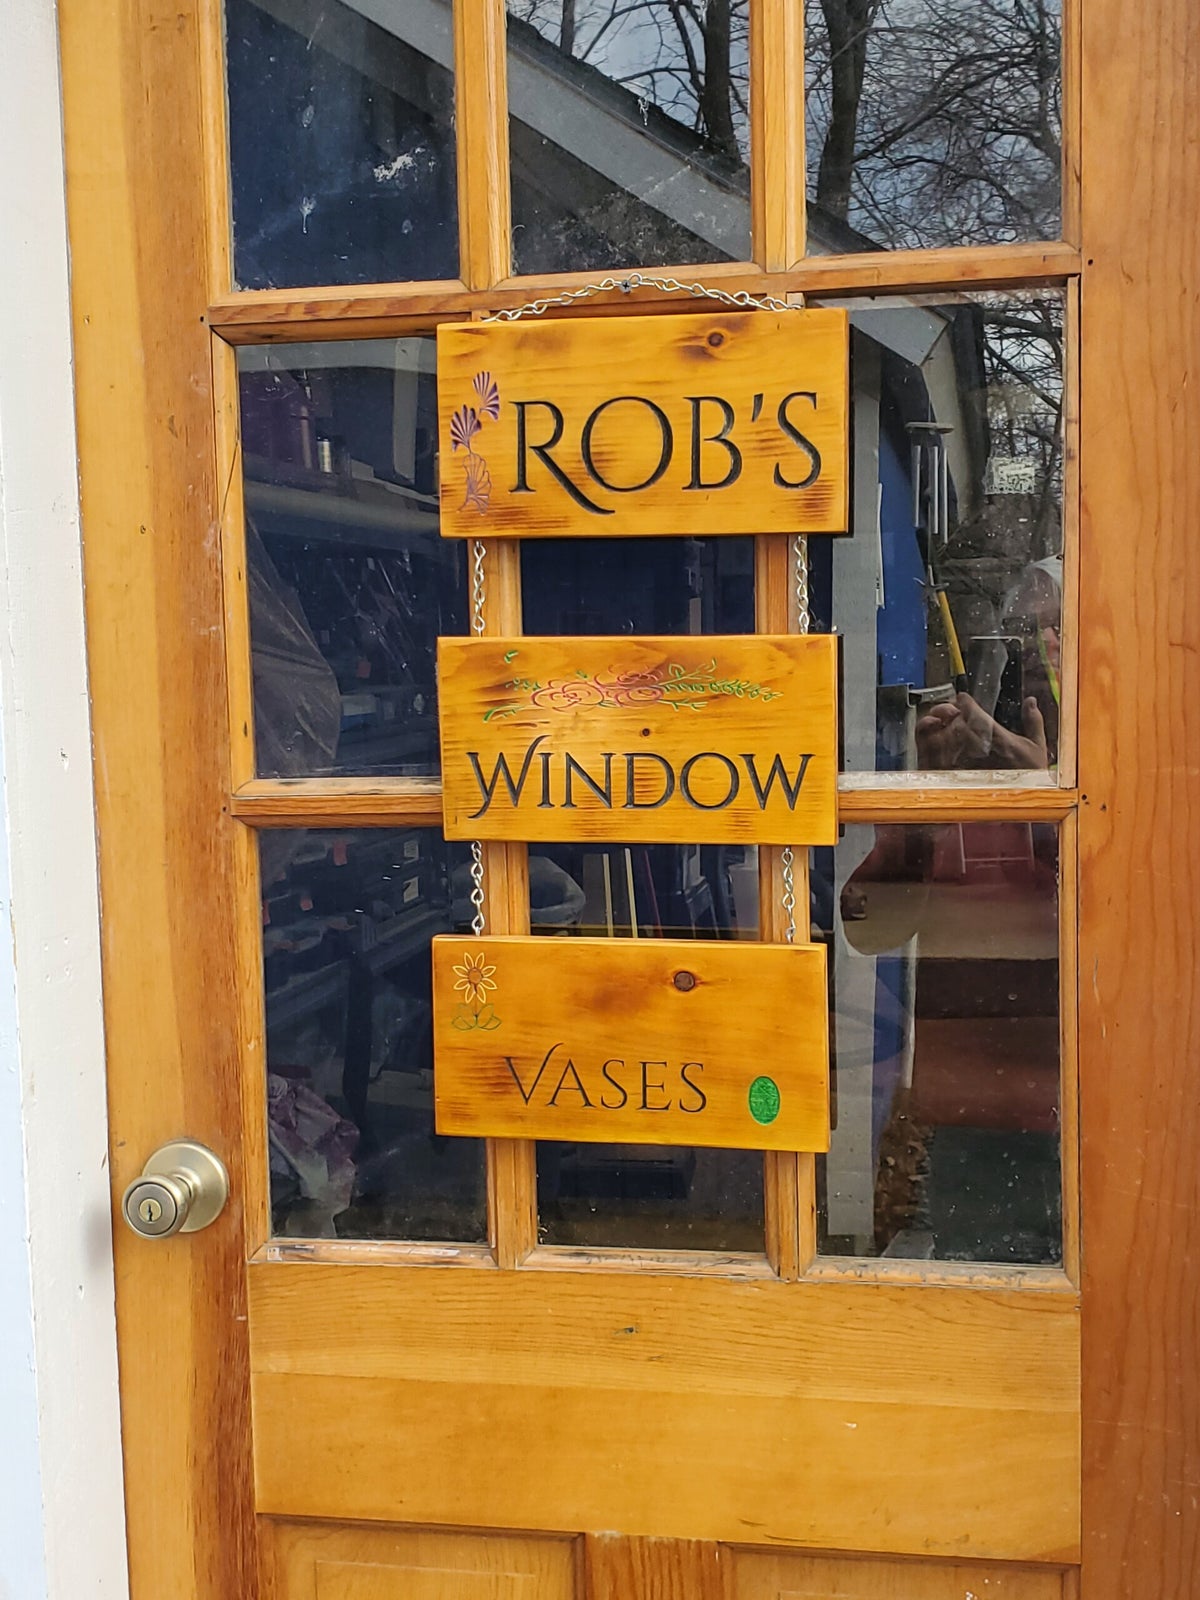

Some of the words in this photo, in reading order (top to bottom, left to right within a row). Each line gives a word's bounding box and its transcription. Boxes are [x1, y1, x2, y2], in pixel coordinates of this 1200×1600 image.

[508, 391, 822, 515] ROB'S
[466, 734, 816, 819] WINDOW
[504, 1042, 707, 1113] VASES
